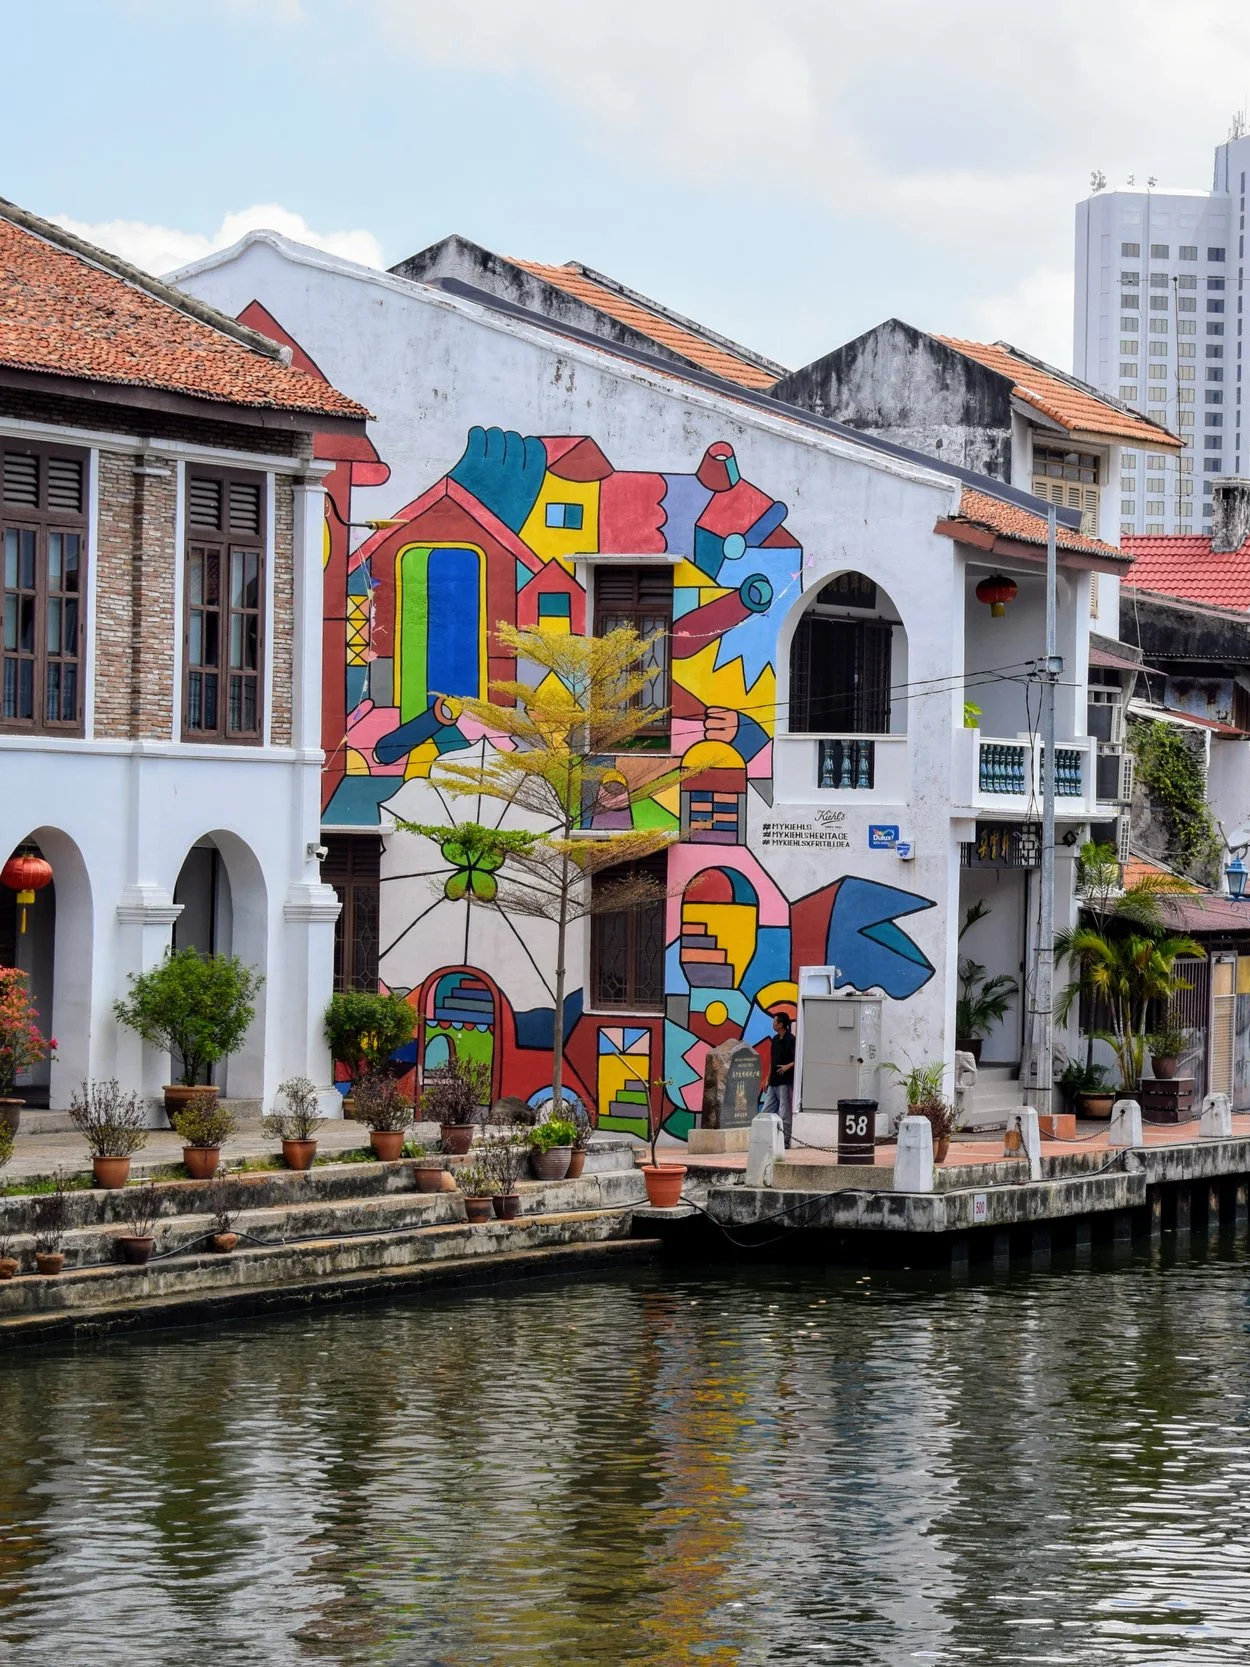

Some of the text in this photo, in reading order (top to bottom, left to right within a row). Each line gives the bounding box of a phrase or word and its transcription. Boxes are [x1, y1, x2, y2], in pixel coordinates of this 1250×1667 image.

[814, 809, 847, 825] Kiehl's
[762, 831, 848, 840] #MYKIEHLSHERITAGE
[845, 1114, 868, 1136] 58
